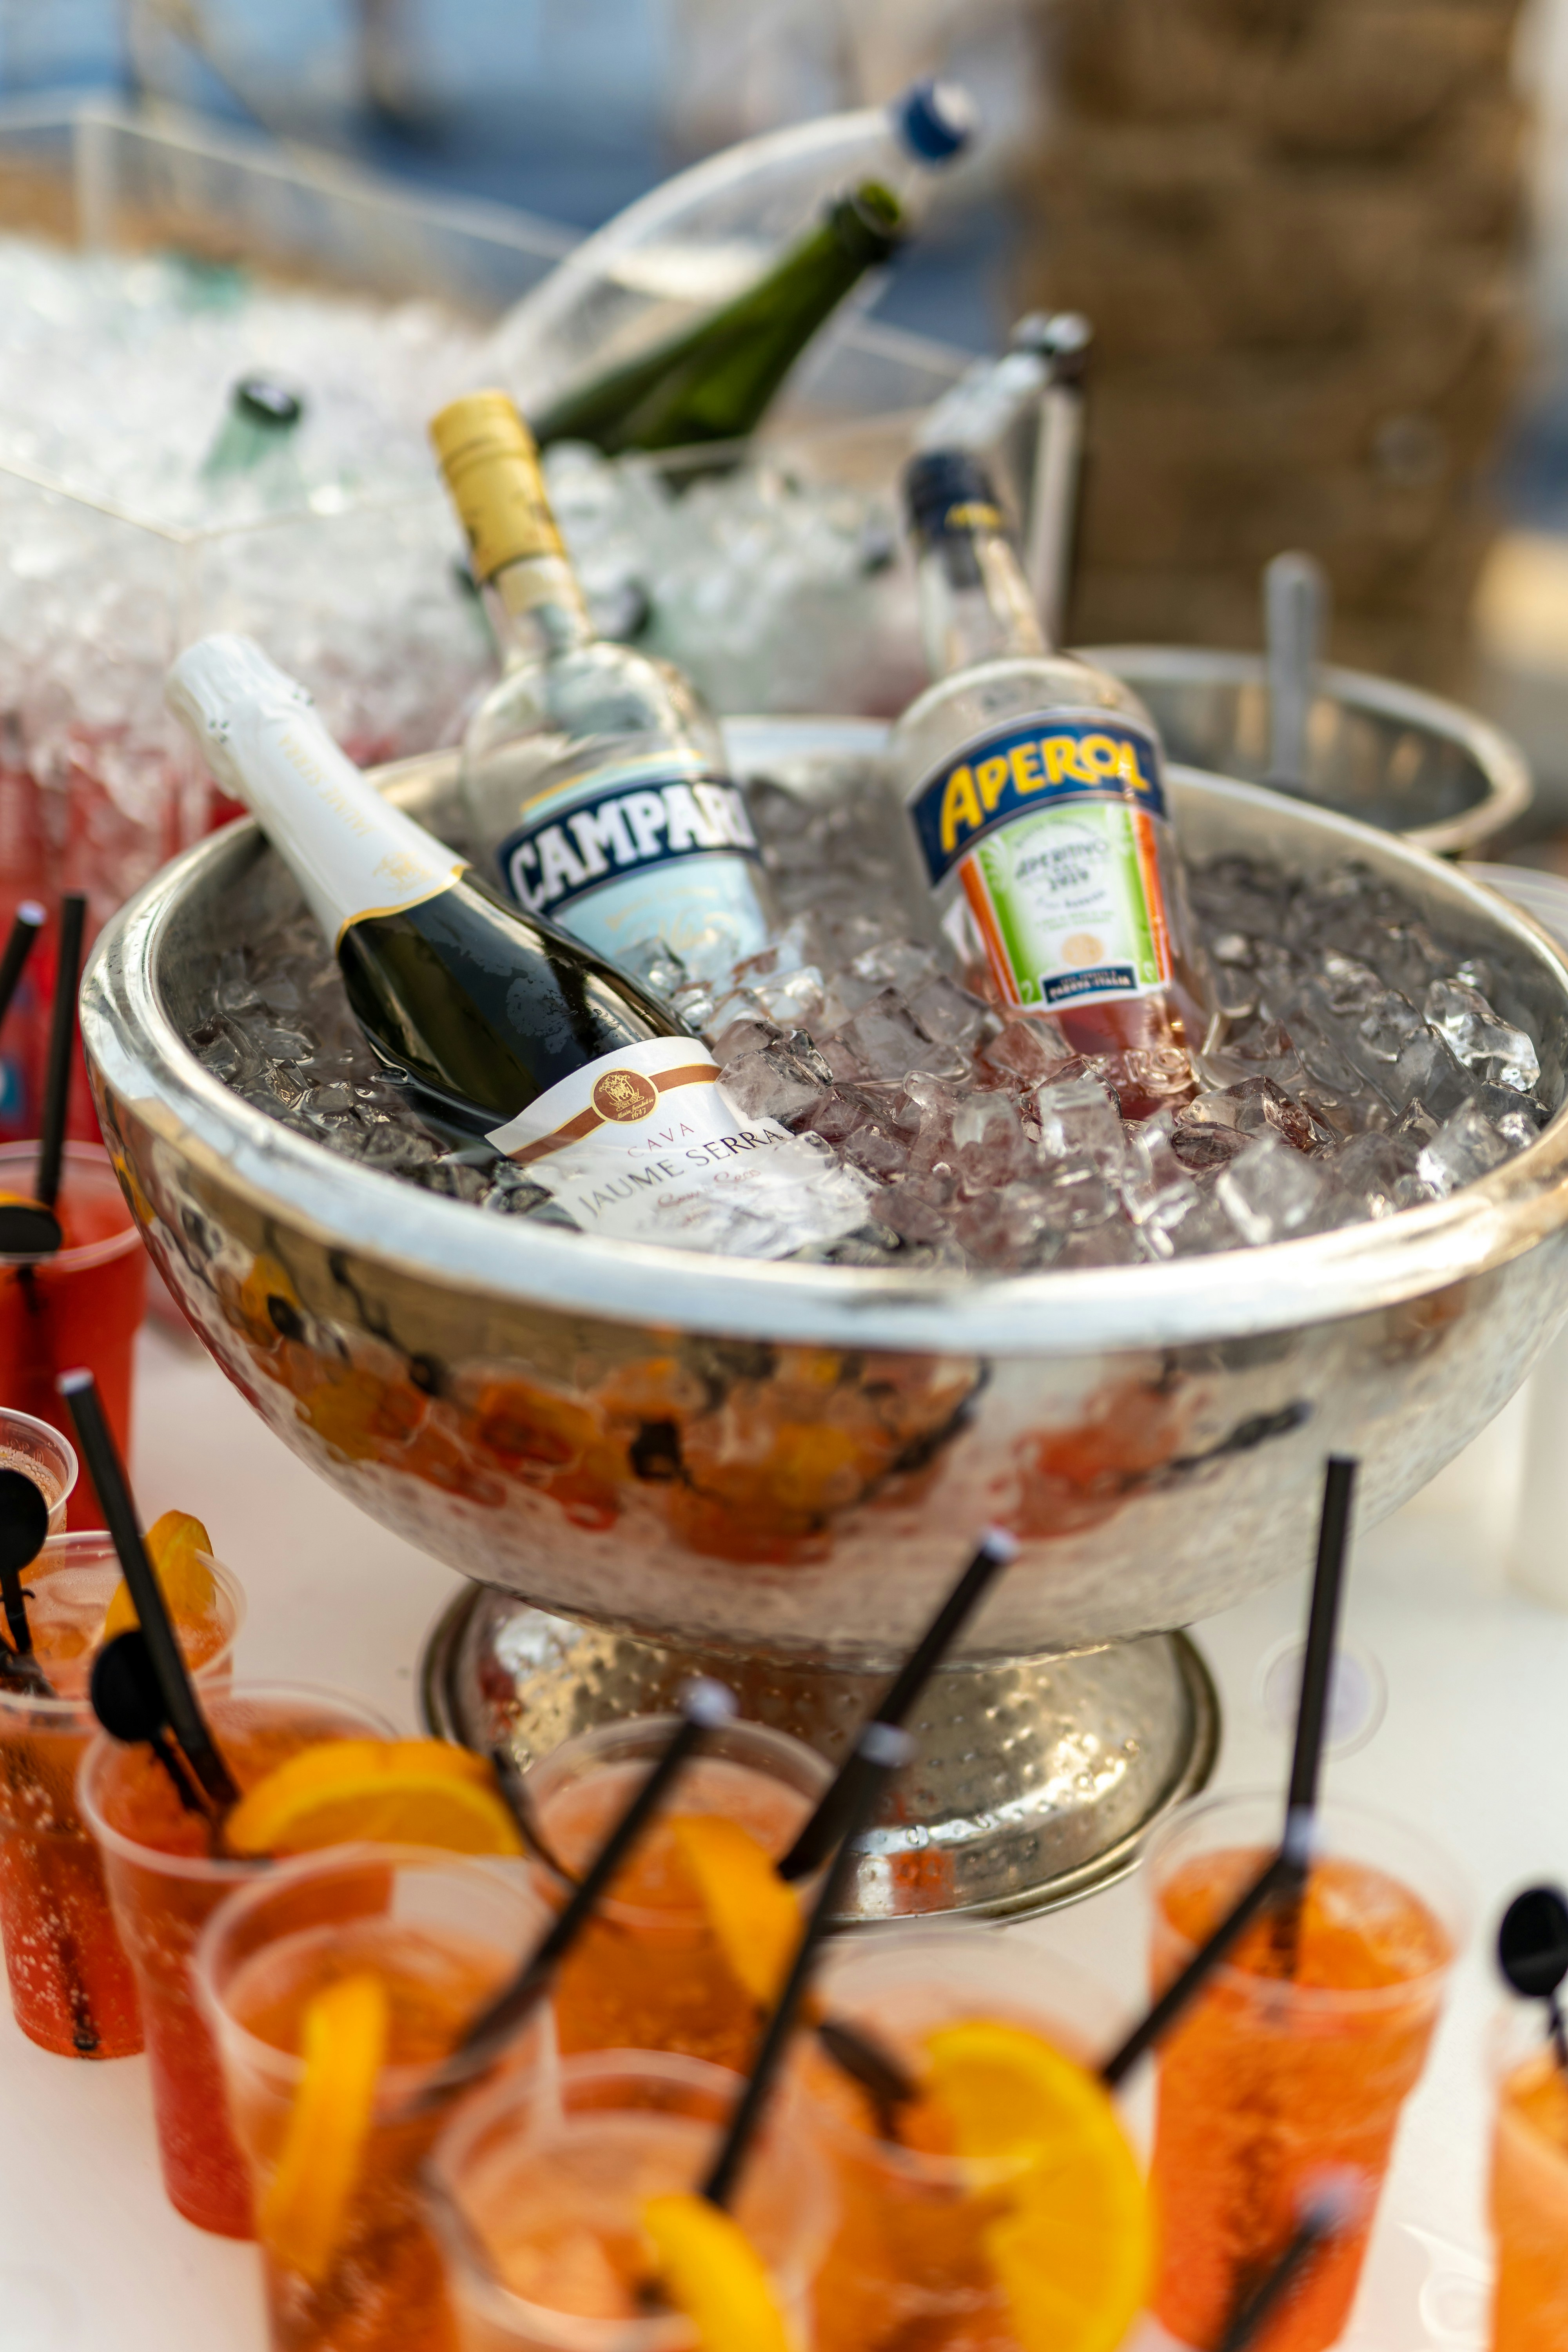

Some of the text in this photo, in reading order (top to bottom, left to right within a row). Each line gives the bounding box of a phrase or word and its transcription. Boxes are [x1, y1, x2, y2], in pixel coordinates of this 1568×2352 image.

[940, 735, 1150, 853] APEROL
[630, 1098, 649, 1114] founded
[632, 1107, 646, 1120] 1647
[628, 1123, 694, 1158] CAVA
[578, 1159, 684, 1220] JAUME
[686, 1129, 786, 1167] SERRA
